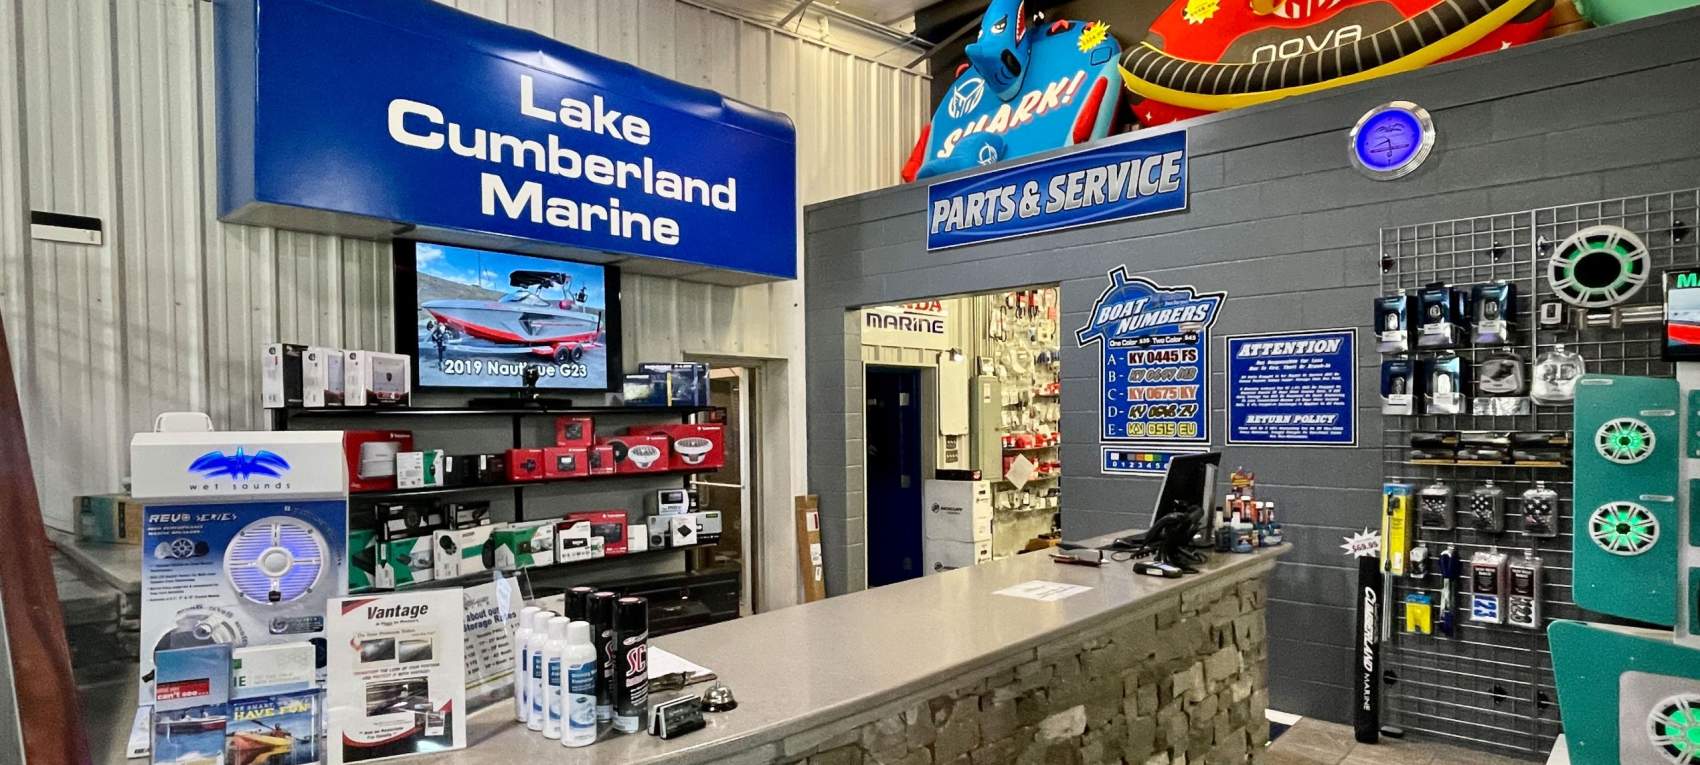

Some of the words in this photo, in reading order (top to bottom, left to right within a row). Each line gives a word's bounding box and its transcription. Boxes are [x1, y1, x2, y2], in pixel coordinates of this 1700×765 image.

[1252, 24, 1362, 64] NOVA
[520, 74, 650, 145] Lake
[388, 98, 737, 212] Cumberland
[930, 184, 1017, 234] PARTS
[1019, 180, 1041, 219] &
[1045, 150, 1184, 215] SERVICE
[481, 172, 680, 245] Marine
[1097, 297, 1150, 324] BOAT
[1116, 303, 1210, 335] NUMBERS
[866, 312, 944, 334] MARINE
[1128, 351, 1145, 365] KY
[1146, 350, 1179, 364] 0445
[1181, 349, 1197, 362] FS
[1238, 338, 1341, 357] ATTENTION
[444, 360, 482, 376] 2019
[487, 361, 556, 377] Nautue
[560, 364, 587, 378] G23
[1128, 387, 1145, 400] KY
[1246, 415, 1292, 424] RETURN
[1293, 414, 1336, 424] POLICY
[189, 483, 219, 491] wet
[232, 482, 291, 490] sounds
[367, 604, 429, 620] Vantage
[1364, 586, 1377, 672] CUMBERLAND
[1363, 673, 1372, 711] MARINE
[234, 706, 274, 721] HAVE
